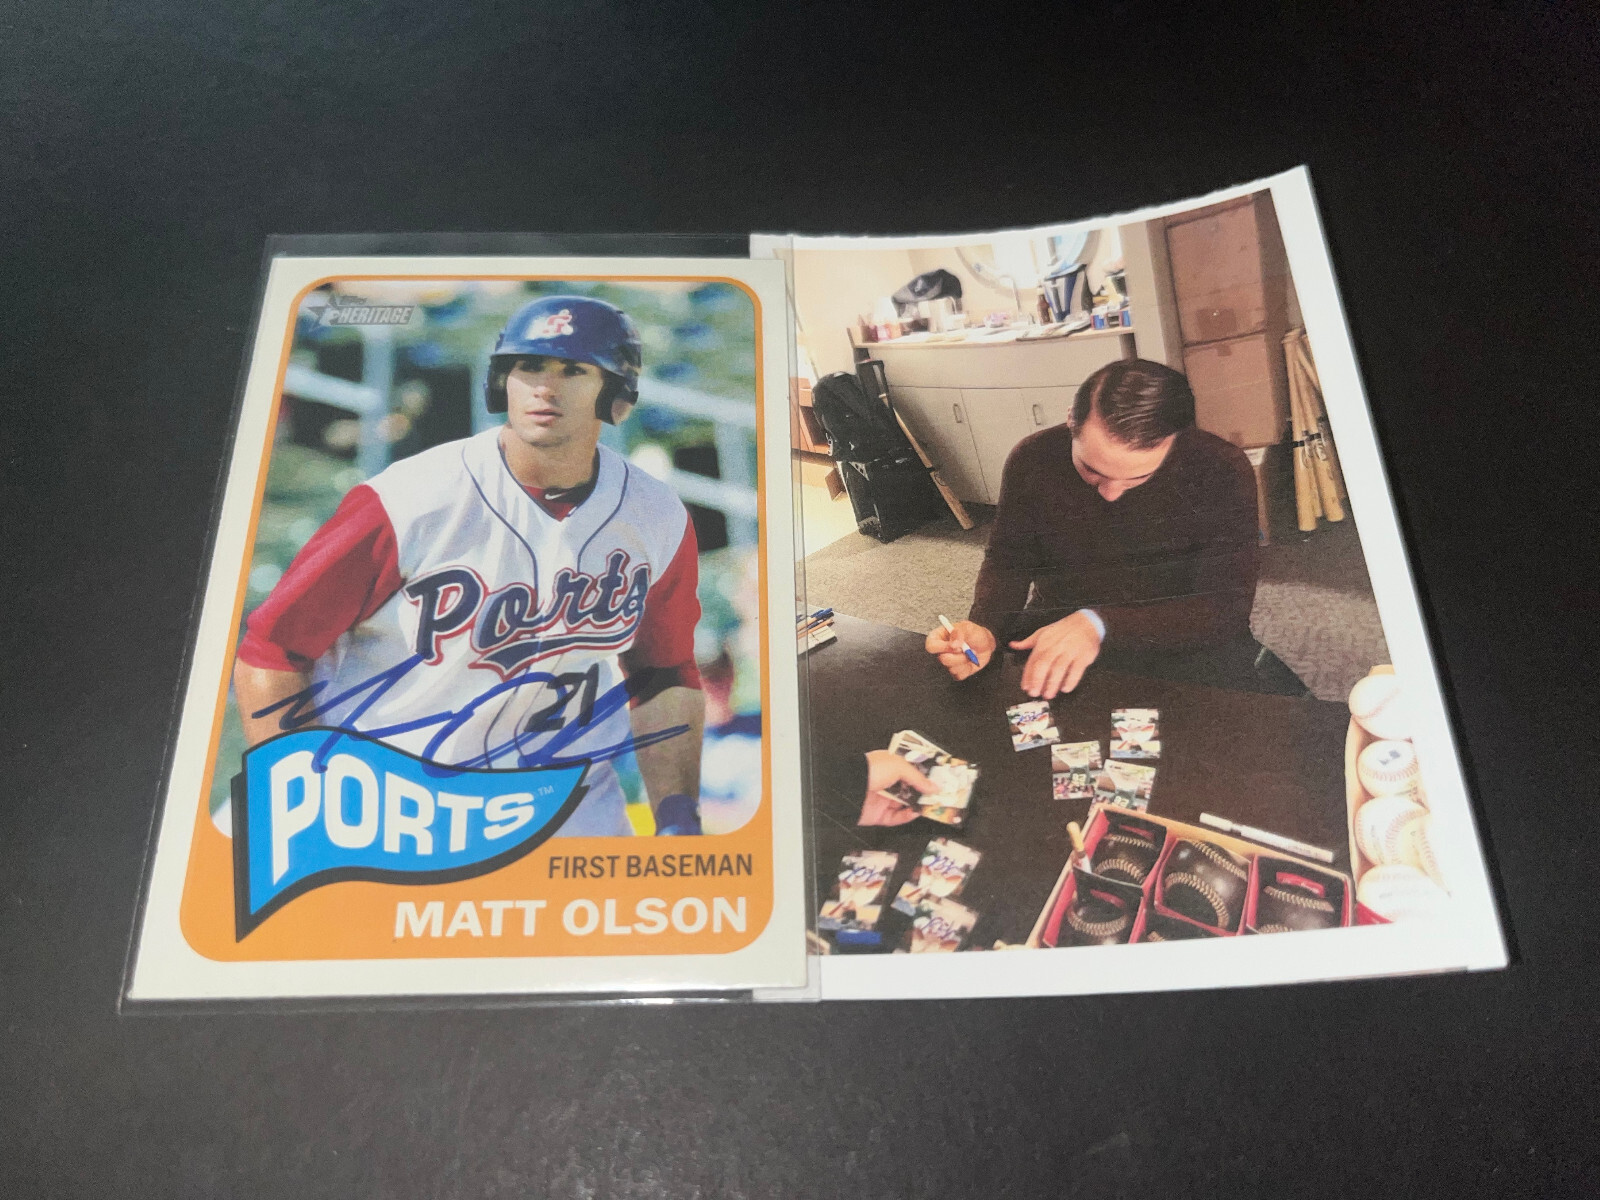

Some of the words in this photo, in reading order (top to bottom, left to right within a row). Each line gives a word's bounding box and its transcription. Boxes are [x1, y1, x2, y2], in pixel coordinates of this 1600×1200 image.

[338, 306, 412, 324] HERITAGE
[400, 549, 650, 667] Ports
[523, 662, 600, 732] 21
[269, 750, 535, 886] PORTS
[548, 855, 620, 878] FIRST
[626, 854, 753, 877] BASEMAN
[395, 900, 547, 937] MATT
[562, 897, 747, 935] OLSON
